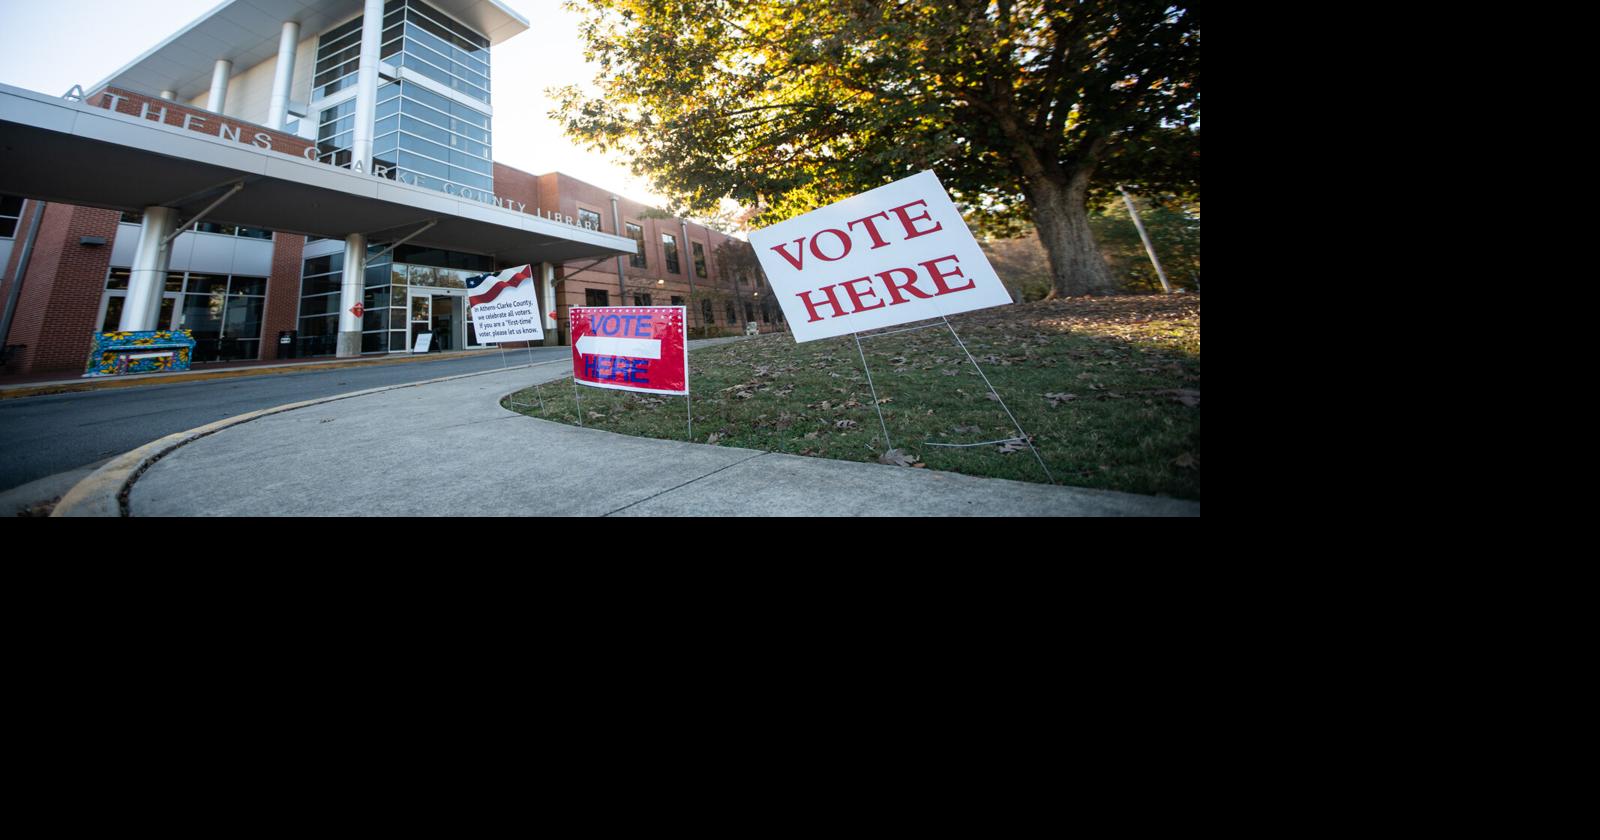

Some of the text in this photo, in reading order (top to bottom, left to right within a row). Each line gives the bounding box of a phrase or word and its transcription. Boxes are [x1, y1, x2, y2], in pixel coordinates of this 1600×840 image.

[63, 84, 274, 150] ATHENS
[536, 207, 600, 233] LIBRARY
[770, 199, 942, 271] VOTE
[796, 254, 976, 323] HERE
[480, 302, 513, 312] Athens-Clarke
[485, 312, 507, 320] celebrate
[484, 322, 493, 330] you
[492, 329, 508, 338] please
[591, 314, 652, 337] VOTE
[585, 355, 649, 383] HERE
